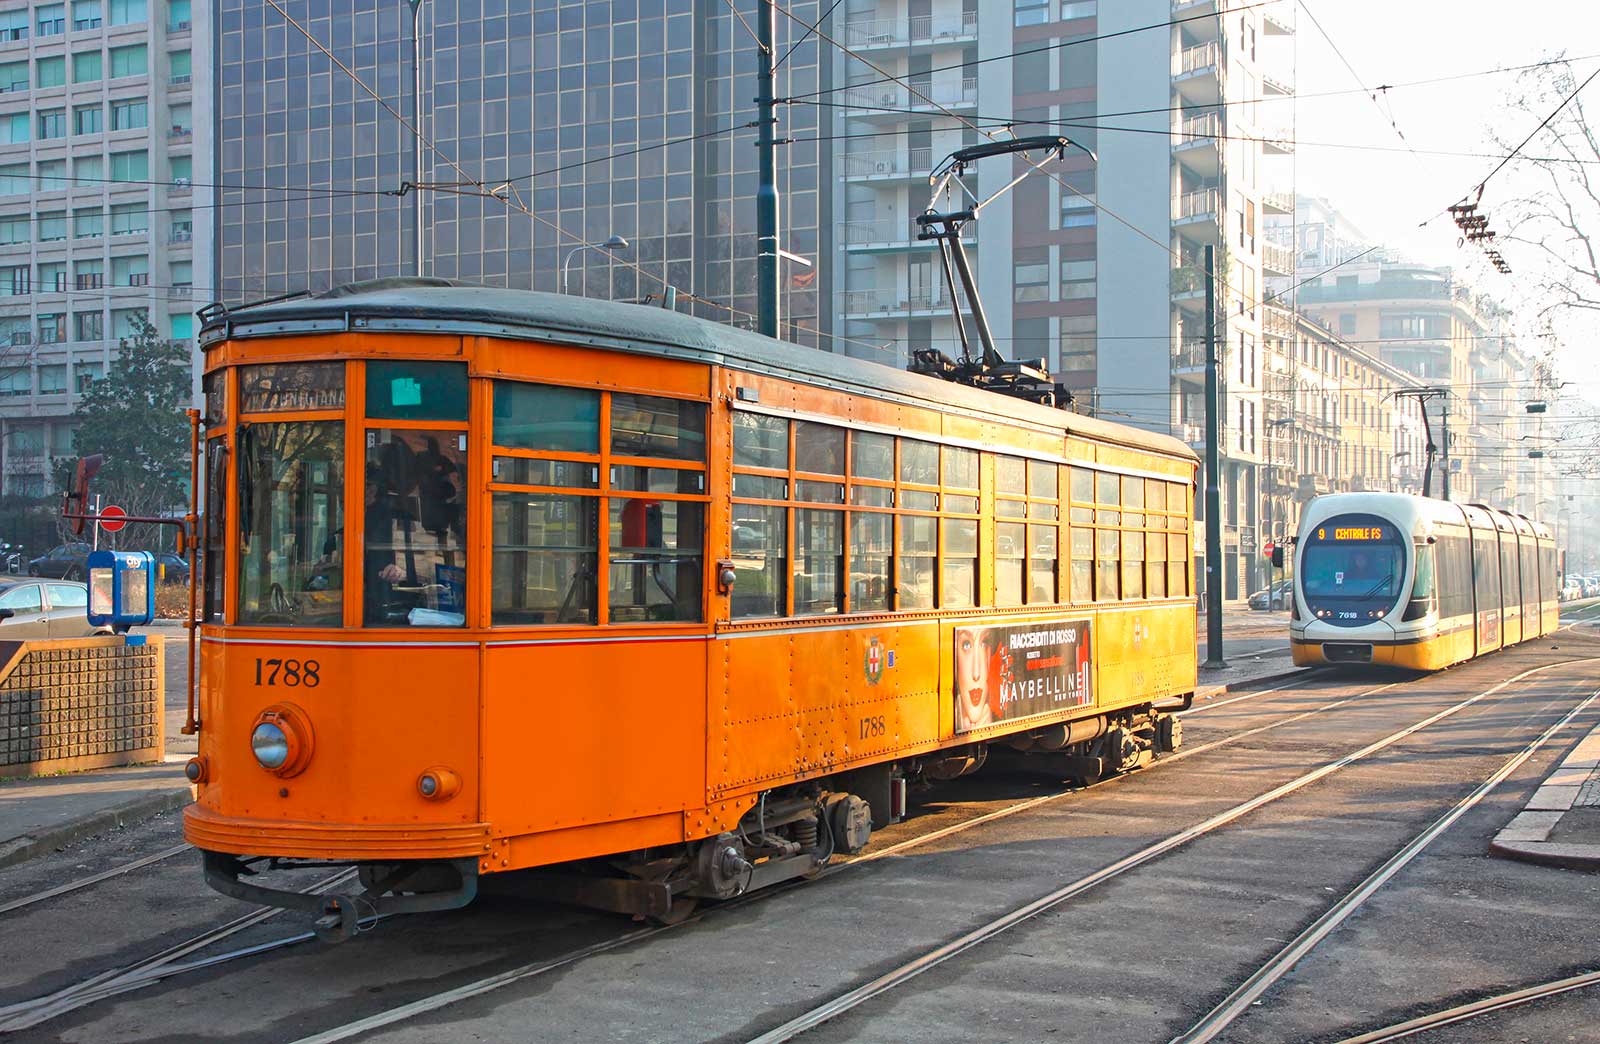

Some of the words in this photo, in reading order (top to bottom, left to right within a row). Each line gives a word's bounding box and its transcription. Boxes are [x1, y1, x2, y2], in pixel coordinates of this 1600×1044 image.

[1318, 528, 1326, 541] 9
[1335, 527, 1370, 541] CENTRALE
[1371, 527, 1382, 541] FS
[1010, 631, 1049, 649] RIACCENDITI
[1049, 630, 1056, 645] DI
[1056, 628, 1077, 644] ROSSO
[255, 658, 321, 688] 1788
[1000, 672, 1083, 704] MAYBELLINE
[1054, 692, 1067, 702] NEW
[859, 715, 886, 740] 1788
